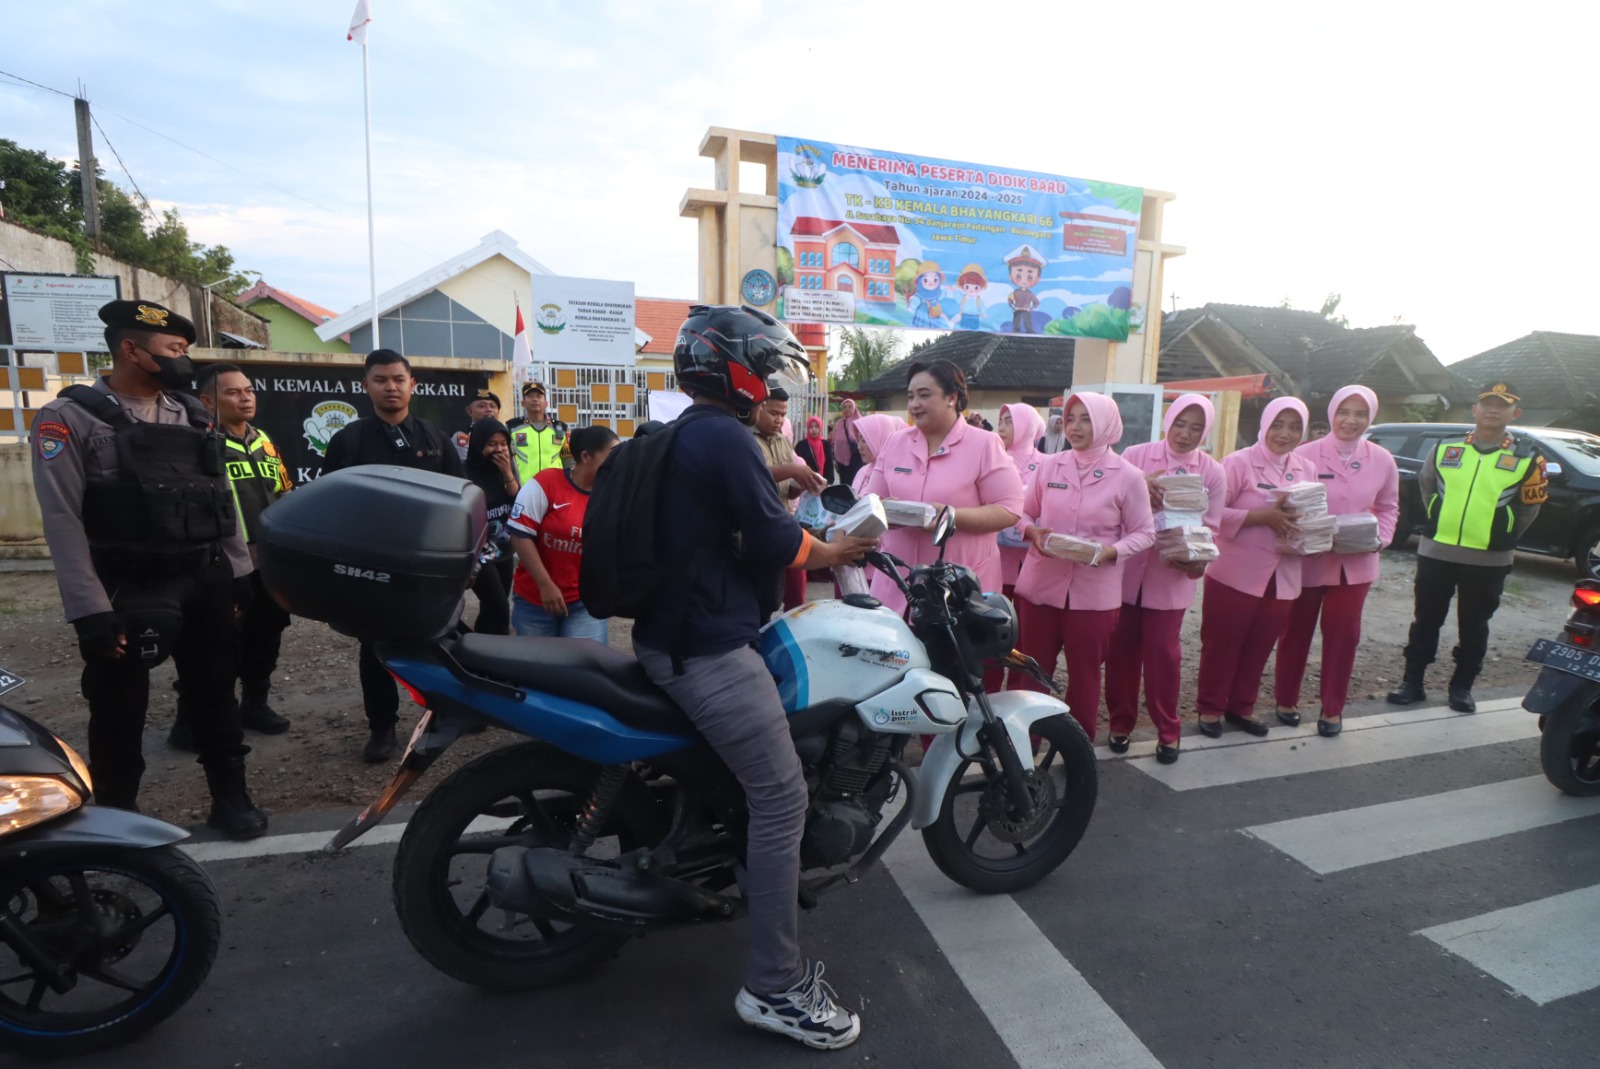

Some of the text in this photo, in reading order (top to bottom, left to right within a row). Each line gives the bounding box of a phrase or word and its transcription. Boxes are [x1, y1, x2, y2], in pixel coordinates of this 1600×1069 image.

[832, 151, 917, 177] MENERIMA
[920, 162, 985, 184] PESERTA
[987, 173, 1028, 189] DIDIK
[1029, 179, 1067, 195] BARU
[884, 180, 920, 194] Tahun
[923, 185, 959, 199] ajaran
[961, 189, 988, 201] 2024
[997, 194, 1023, 204] 2025
[845, 193, 864, 207] TK
[873, 196, 892, 209] KB
[895, 198, 948, 215] KEMALA
[949, 204, 1037, 225] BHAYANGKARI
[1039, 215, 1054, 227] 66
[856, 211, 897, 223] Surabaya
[926, 218, 965, 230] Banjarejo
[966, 222, 1005, 234] Padangan
[1011, 227, 1053, 239] Bojonegoro
[931, 233, 977, 244] Jawa Timur
[273, 378, 346, 393] KEMALA
[351, 380, 466, 397] BGKARI
[320, 404, 351, 412] YAYASAN
[1523, 486, 1547, 501] KAO
[543, 532, 583, 555] Emir
[333, 563, 391, 583] SH42
[1536, 641, 1600, 667] S 2905 D
[891, 708, 918, 716] listrik
